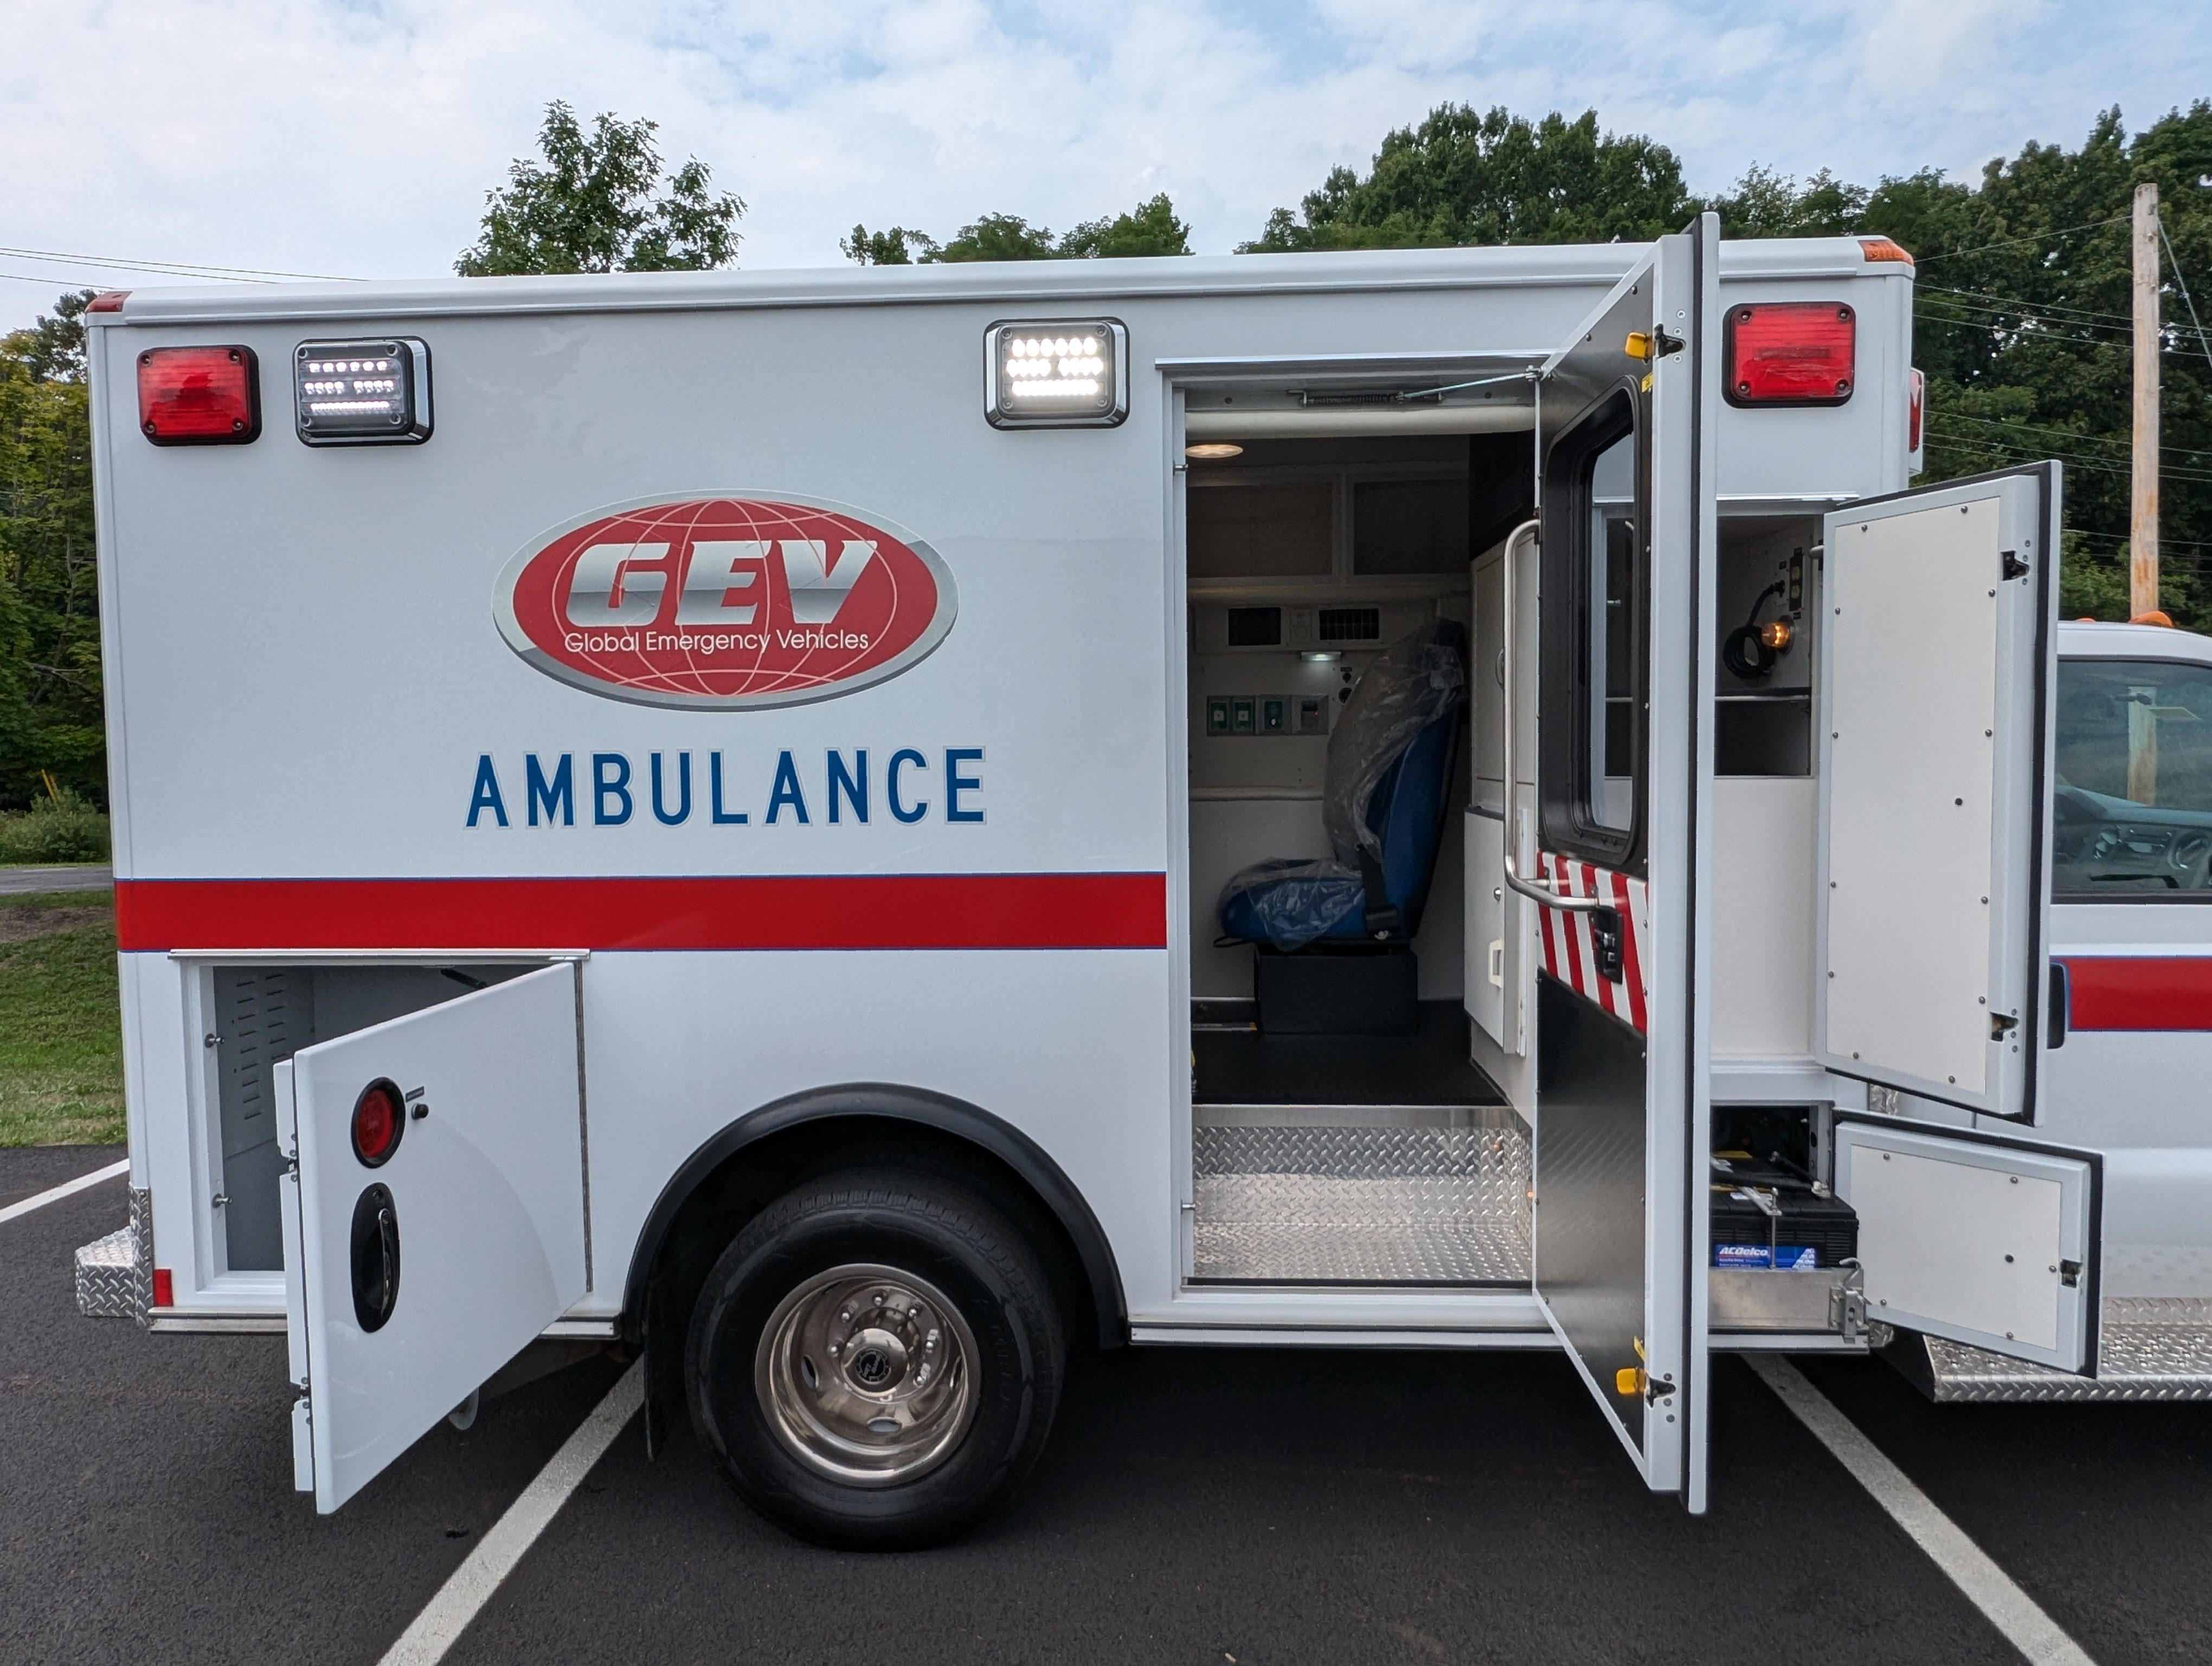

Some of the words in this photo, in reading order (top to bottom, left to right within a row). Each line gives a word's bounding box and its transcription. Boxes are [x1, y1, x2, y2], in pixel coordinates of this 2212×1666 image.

[565, 540, 878, 627] GEV
[564, 632, 639, 652] Global
[646, 631, 771, 655] Emergency
[776, 629, 869, 650] Vehicles
[463, 746, 987, 829] AMBULANCE
[1719, 1247, 1769, 1257] ACDelco
